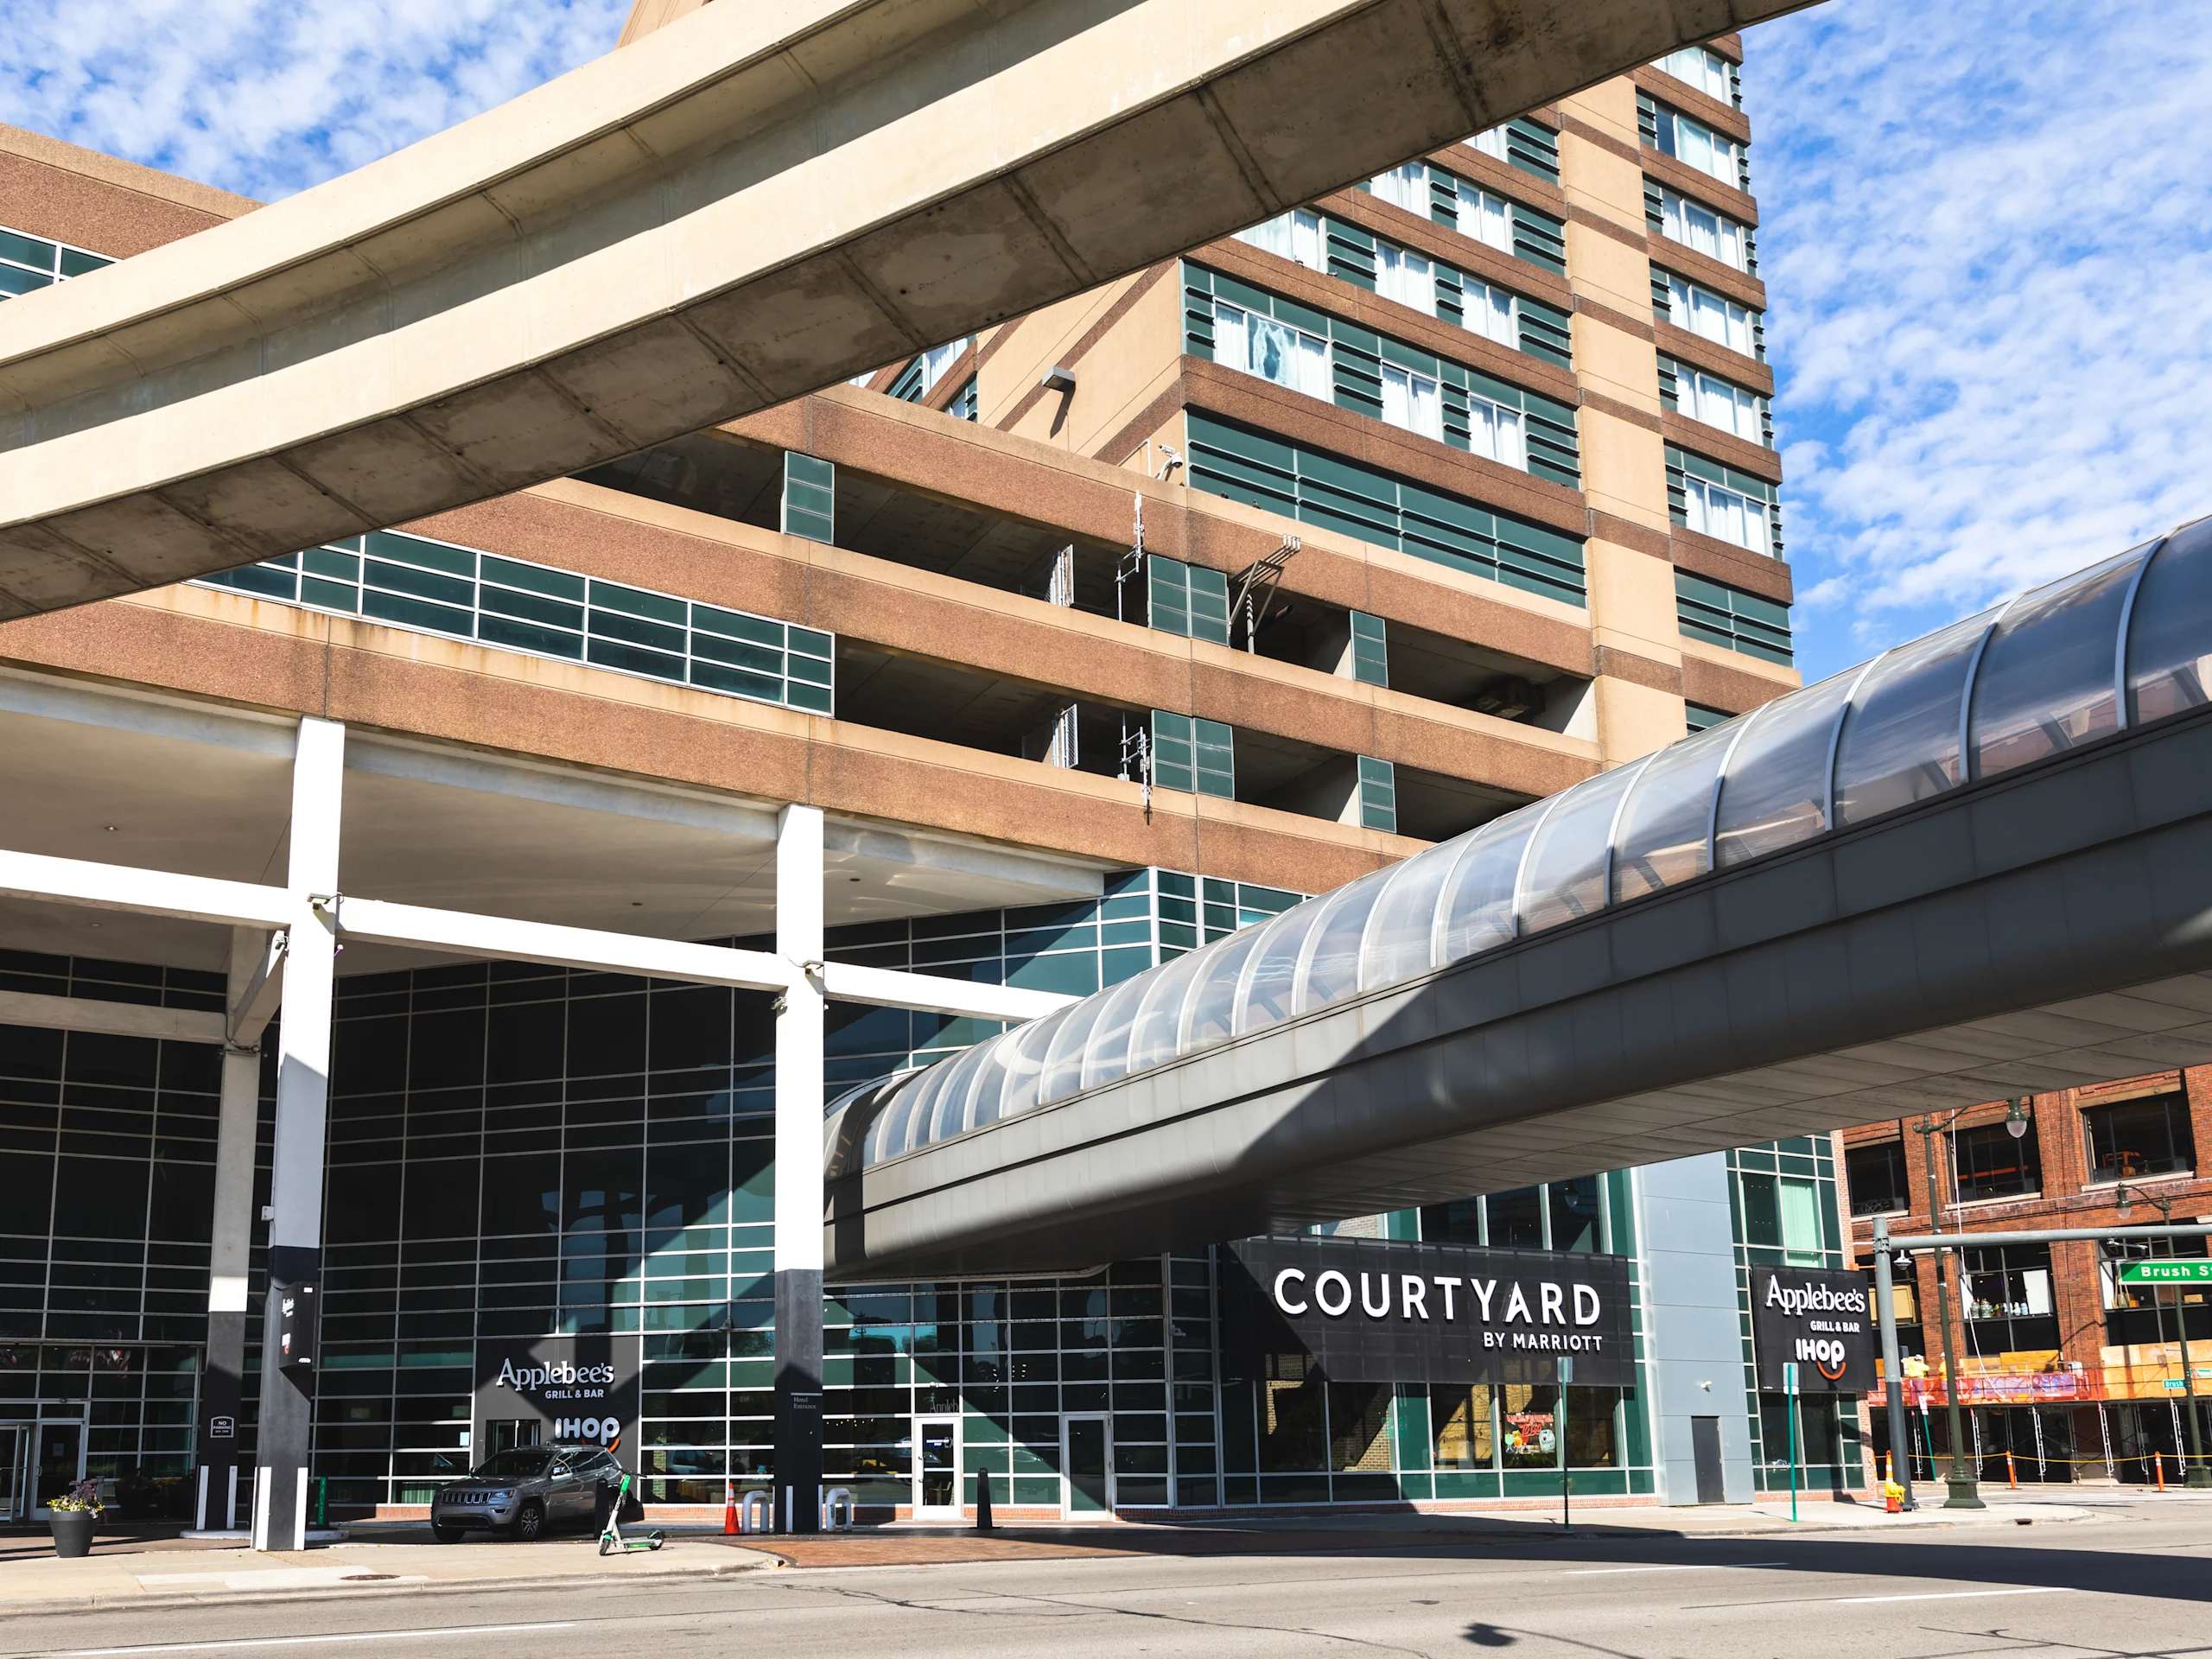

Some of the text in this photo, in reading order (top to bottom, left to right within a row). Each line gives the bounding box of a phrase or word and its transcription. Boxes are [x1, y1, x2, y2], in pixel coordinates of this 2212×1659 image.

[2141, 1266, 2190, 1277] Brush
[1274, 1268, 1601, 1326] COURTYARD
[1766, 1274, 1866, 1315] Applebee's
[1810, 1320, 1860, 1332] GRILL & BAR
[1484, 1332, 1603, 1351] BY MARRIOTT
[1796, 1338, 1845, 1370] IHOP
[496, 1357, 614, 1391] Applebee's
[545, 1389, 604, 1399] GRILL & BAR
[555, 1417, 620, 1446] IHOP
